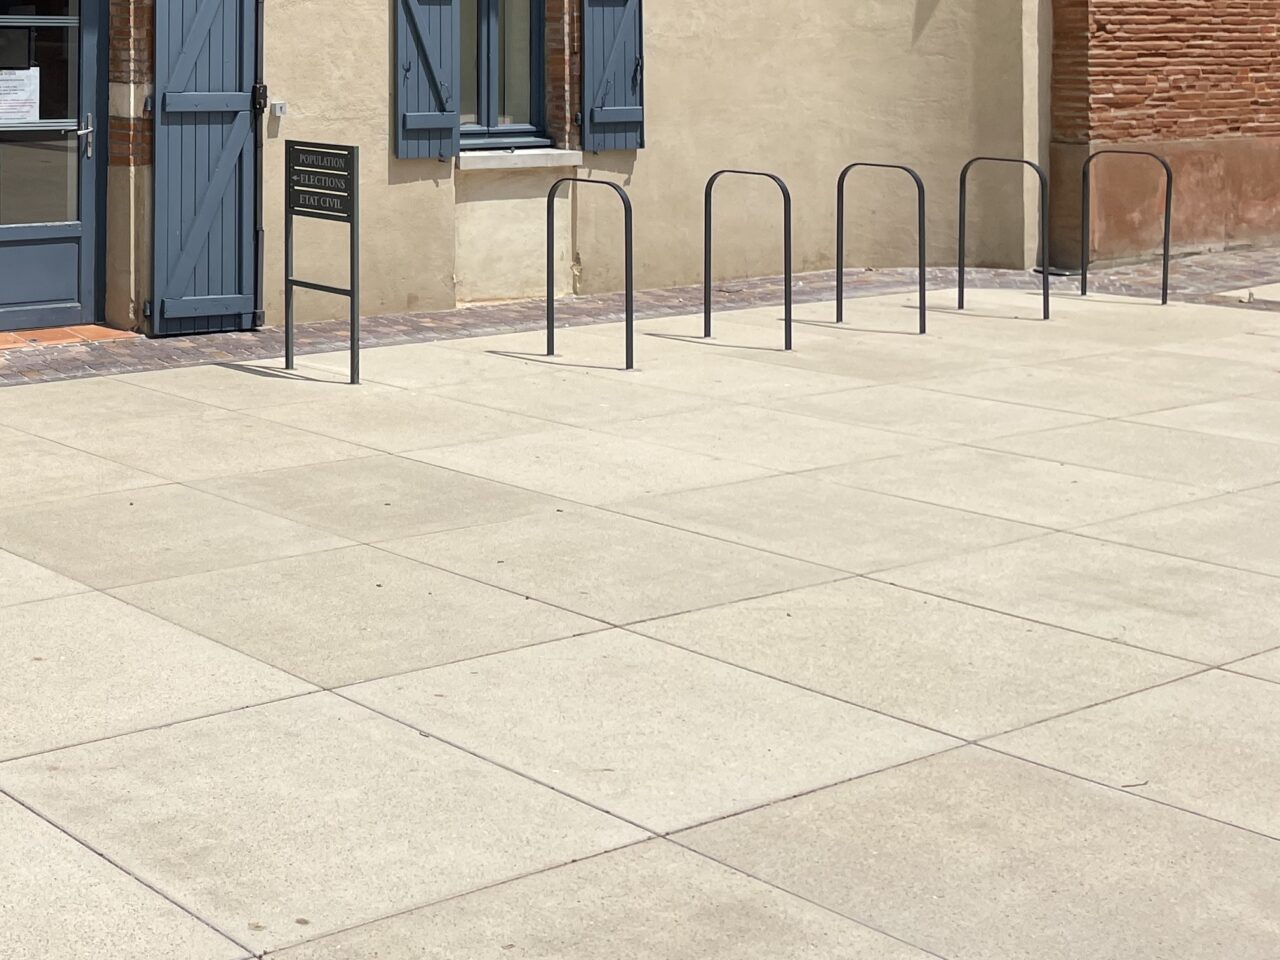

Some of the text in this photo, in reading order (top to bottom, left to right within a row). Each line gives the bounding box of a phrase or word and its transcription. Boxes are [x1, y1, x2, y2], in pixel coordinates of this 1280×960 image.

[299, 153, 345, 168] POPULATION
[300, 174, 345, 189] ELECTIONS
[299, 194, 342, 208] ETAT CIVIL
